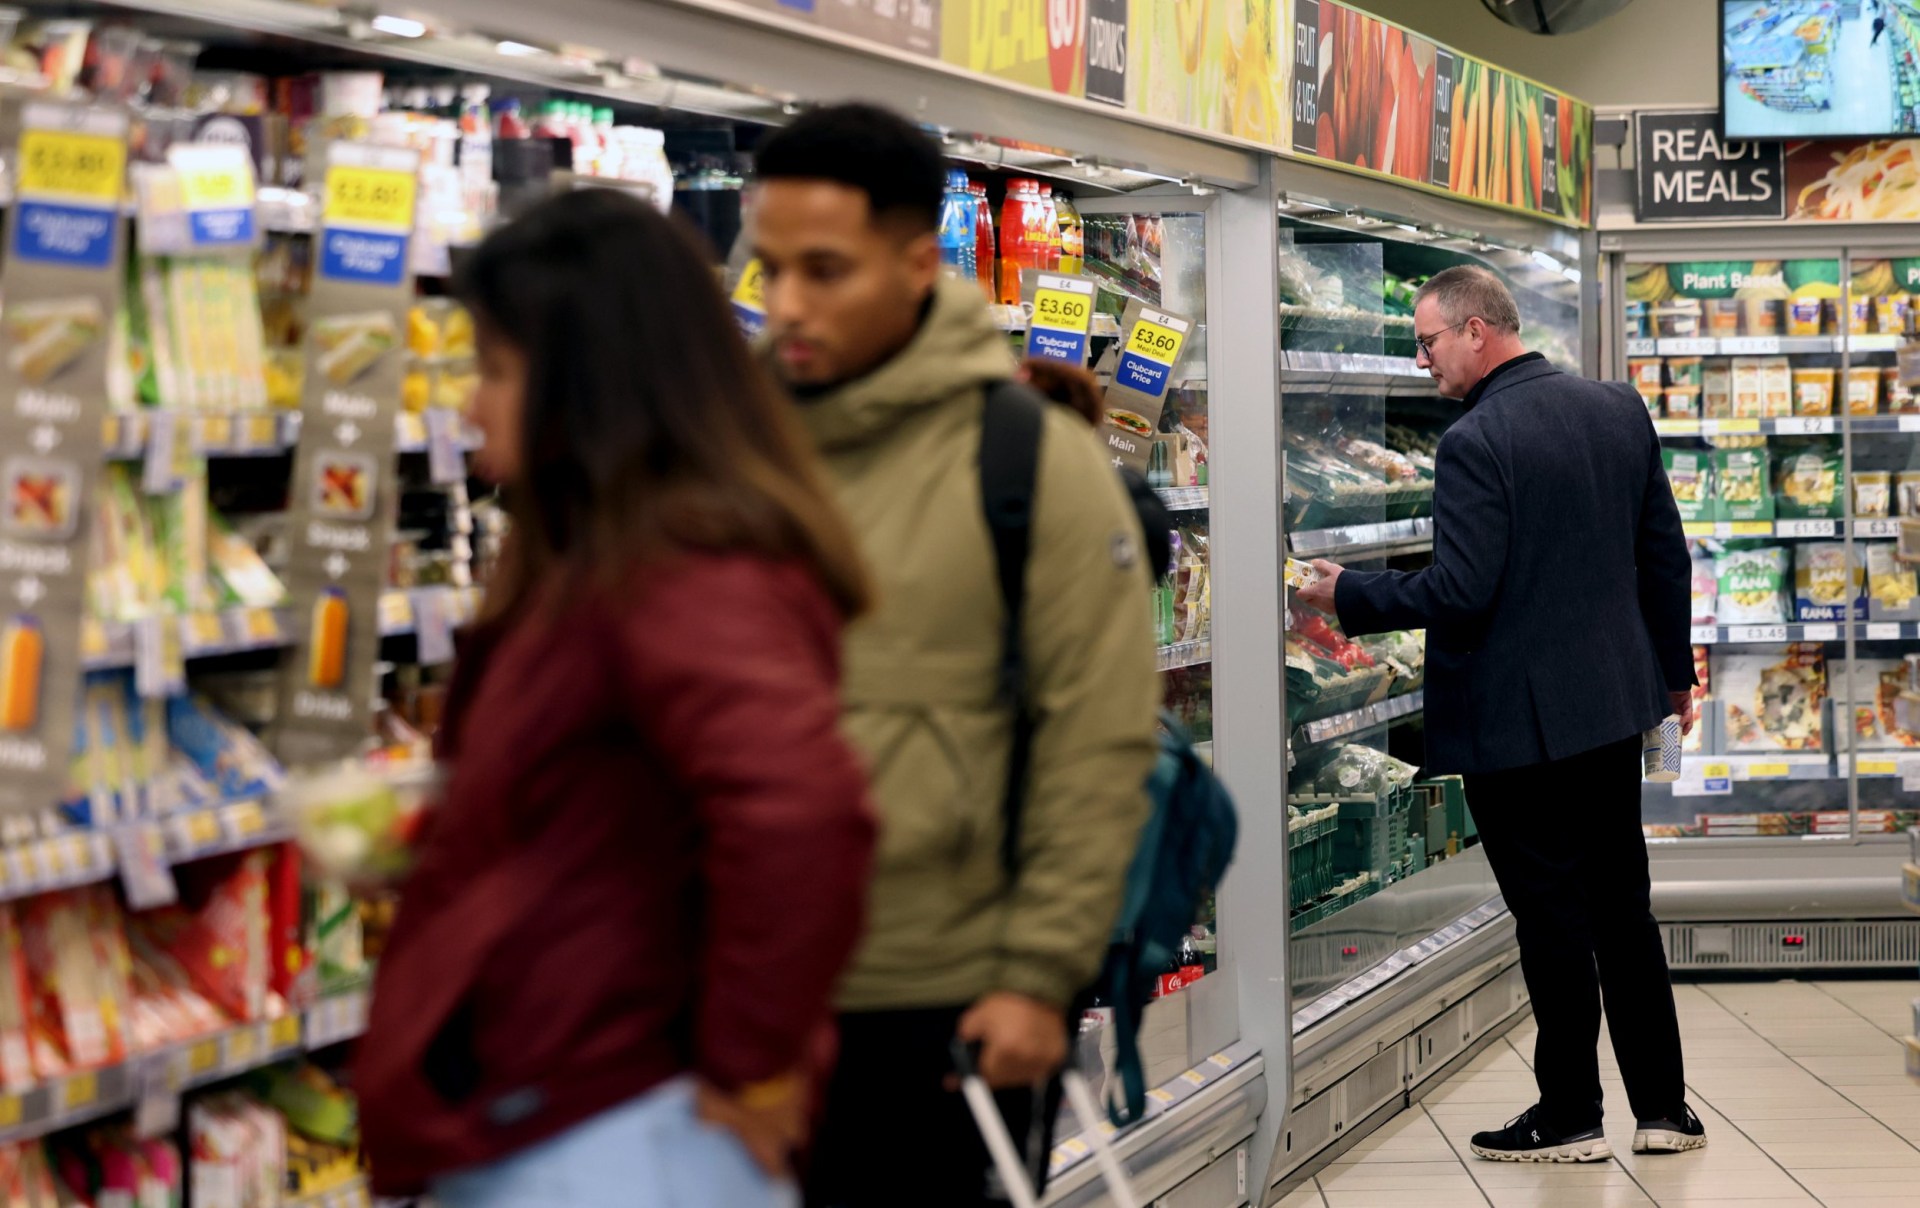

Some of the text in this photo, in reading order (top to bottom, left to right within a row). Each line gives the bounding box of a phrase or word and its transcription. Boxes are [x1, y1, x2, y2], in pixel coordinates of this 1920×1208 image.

[1090, 16, 1125, 74] DRINKS
[1297, 22, 1316, 67] FRUIT
[1436, 74, 1450, 113] FRUIT
[1303, 81, 1316, 126] VEG
[1653, 168, 1773, 203] MEALS
[1059, 280, 1071, 290] £4
[1683, 271, 1783, 289] Plant Based
[1039, 298, 1084, 318] £3.60
[1158, 315, 1169, 325] £4
[1036, 334, 1078, 350] Clubcard
[1135, 328, 1175, 351] £3.60
[1043, 346, 1067, 359] Price
[1126, 360, 1162, 379] Clubcard
[1131, 371, 1152, 385] Price
[1108, 434, 1136, 454] Main
[1794, 522, 1832, 535] £1.55
[1870, 522, 1898, 535] £3.1
[1747, 628, 1785, 640] £3.45
